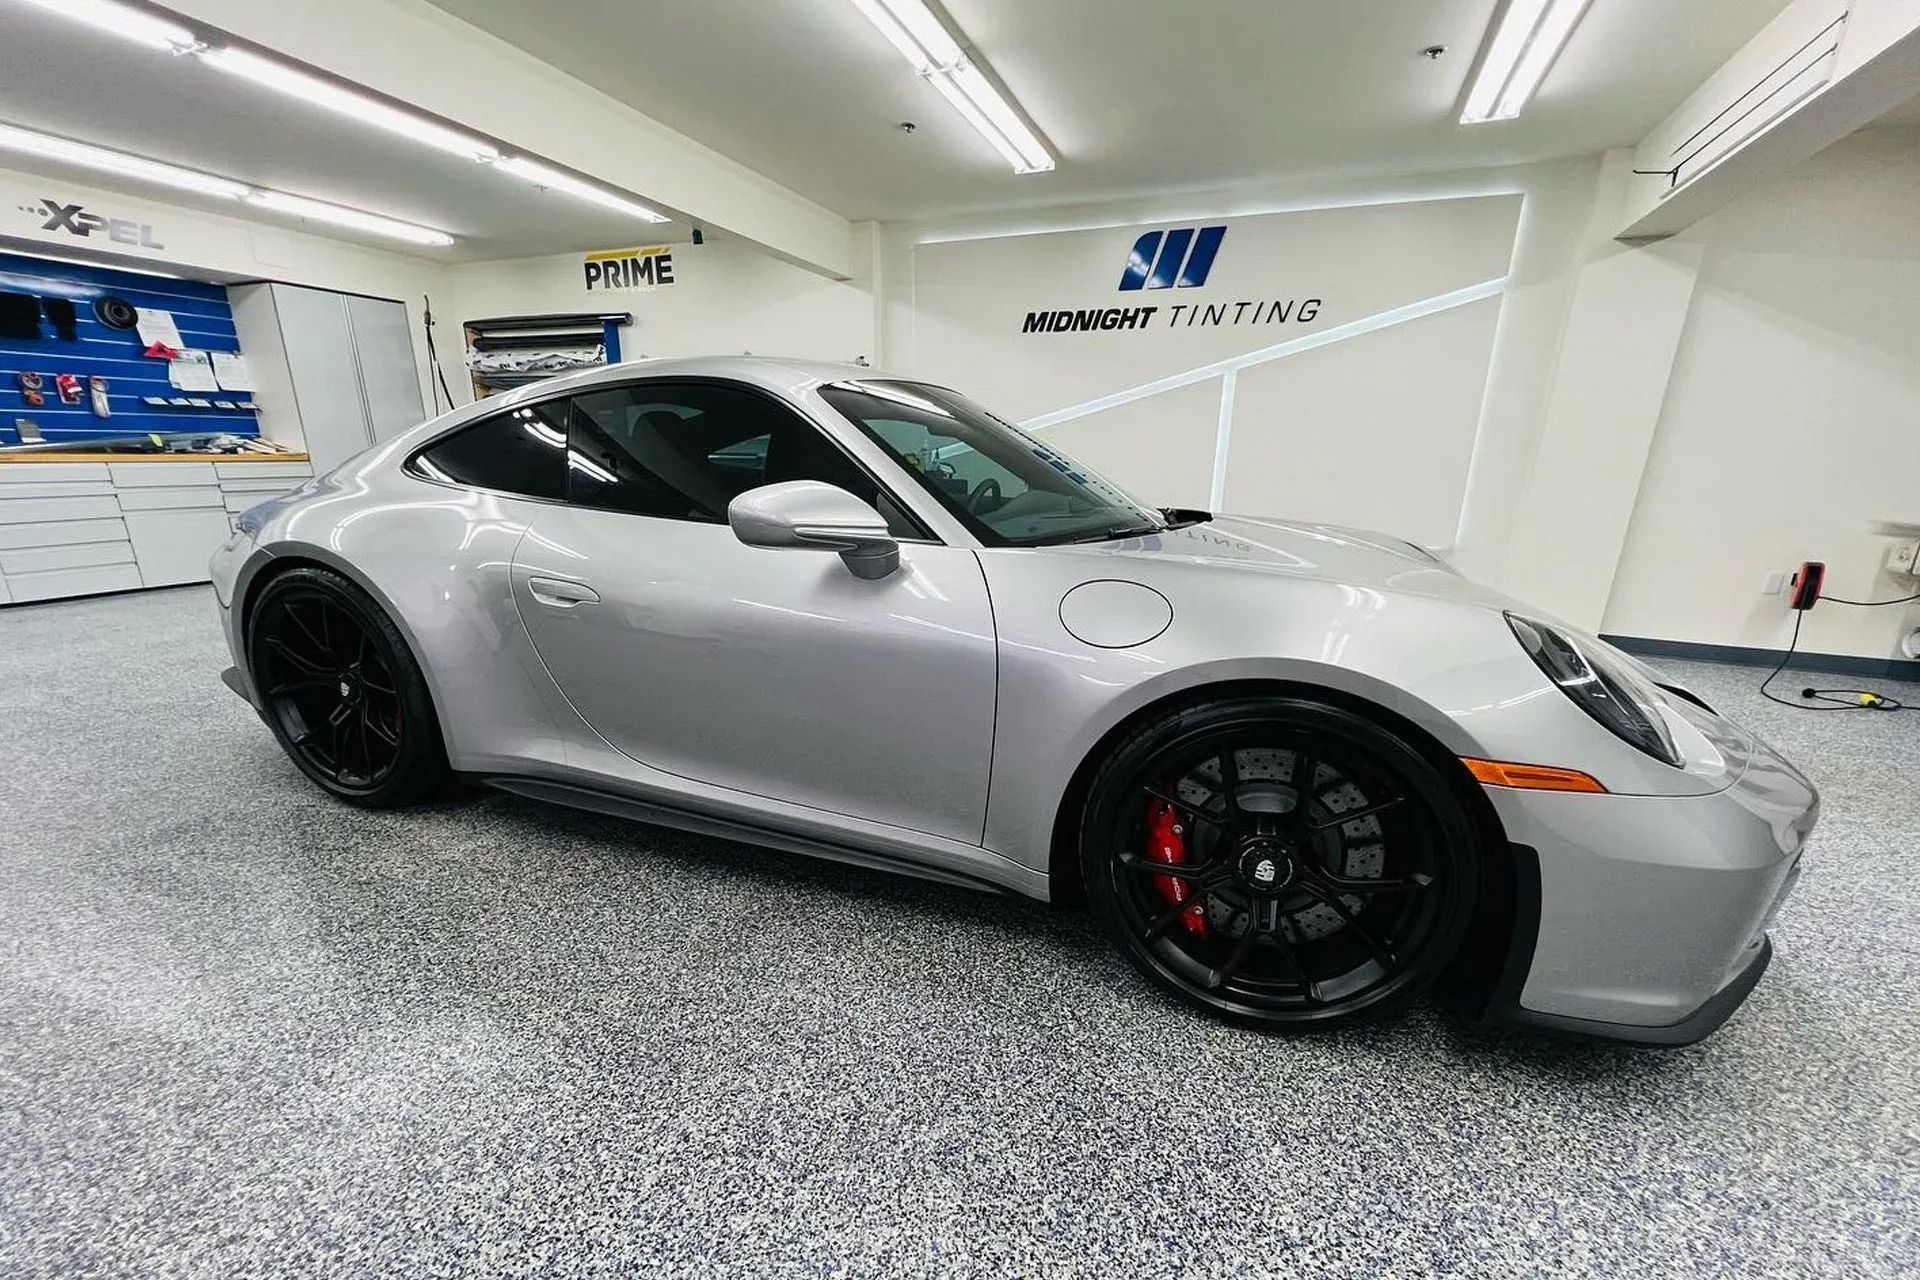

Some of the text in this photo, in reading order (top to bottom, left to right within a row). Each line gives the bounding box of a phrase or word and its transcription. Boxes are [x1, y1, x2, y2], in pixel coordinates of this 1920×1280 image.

[40, 198, 165, 251] XPEL
[584, 254, 675, 290] PRIME
[1022, 299, 1321, 333] MIDNIGHT TINTING
